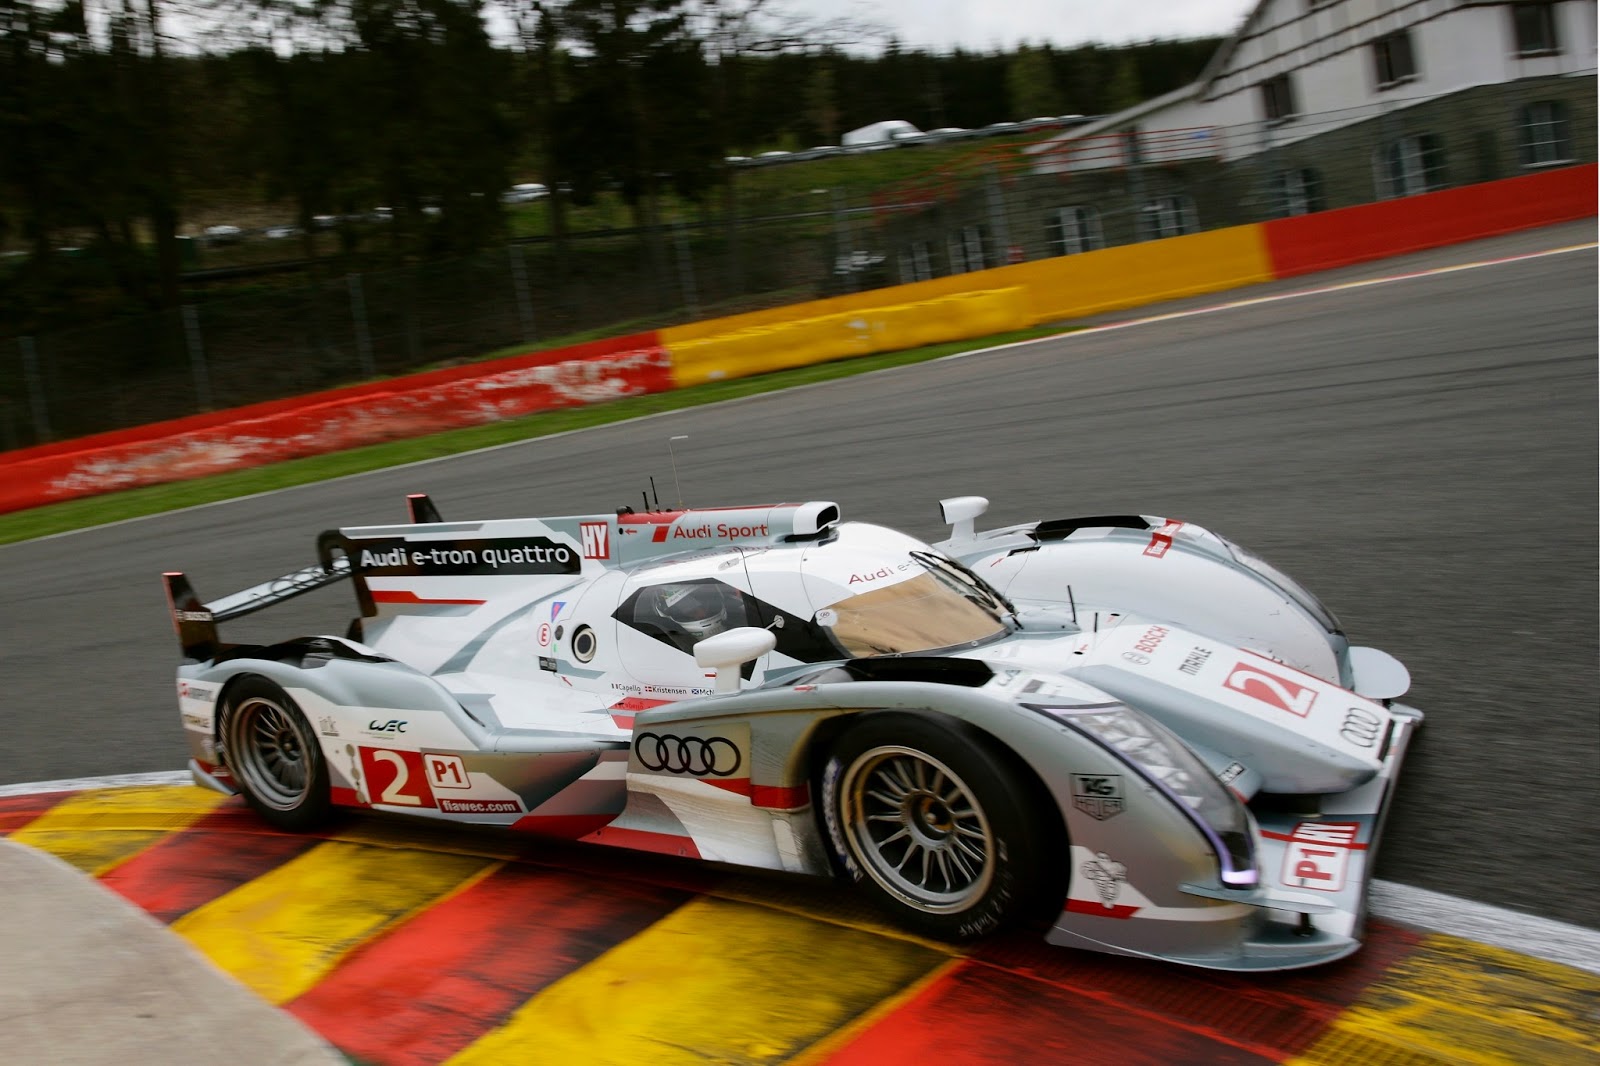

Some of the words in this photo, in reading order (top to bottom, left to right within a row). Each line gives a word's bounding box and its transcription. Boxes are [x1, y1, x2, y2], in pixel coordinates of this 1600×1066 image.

[581, 525, 607, 556] HY
[674, 524, 712, 539] Audi
[717, 524, 768, 540] Sport
[360, 548, 409, 567] Audi
[411, 548, 477, 565] e-tron
[482, 546, 570, 568] quattro
[848, 567, 894, 584] Audi
[541, 627, 548, 642] E
[1134, 625, 1170, 653] BOSCH
[619, 684, 641, 692] Capello
[652, 686, 687, 695] Kristensen
[1228, 670, 1316, 716] 2
[368, 720, 408, 733] WEC
[373, 750, 422, 805] 2
[432, 760, 462, 783] P1
[442, 800, 516, 812] fiawec.com
[1295, 848, 1337, 881] P1
